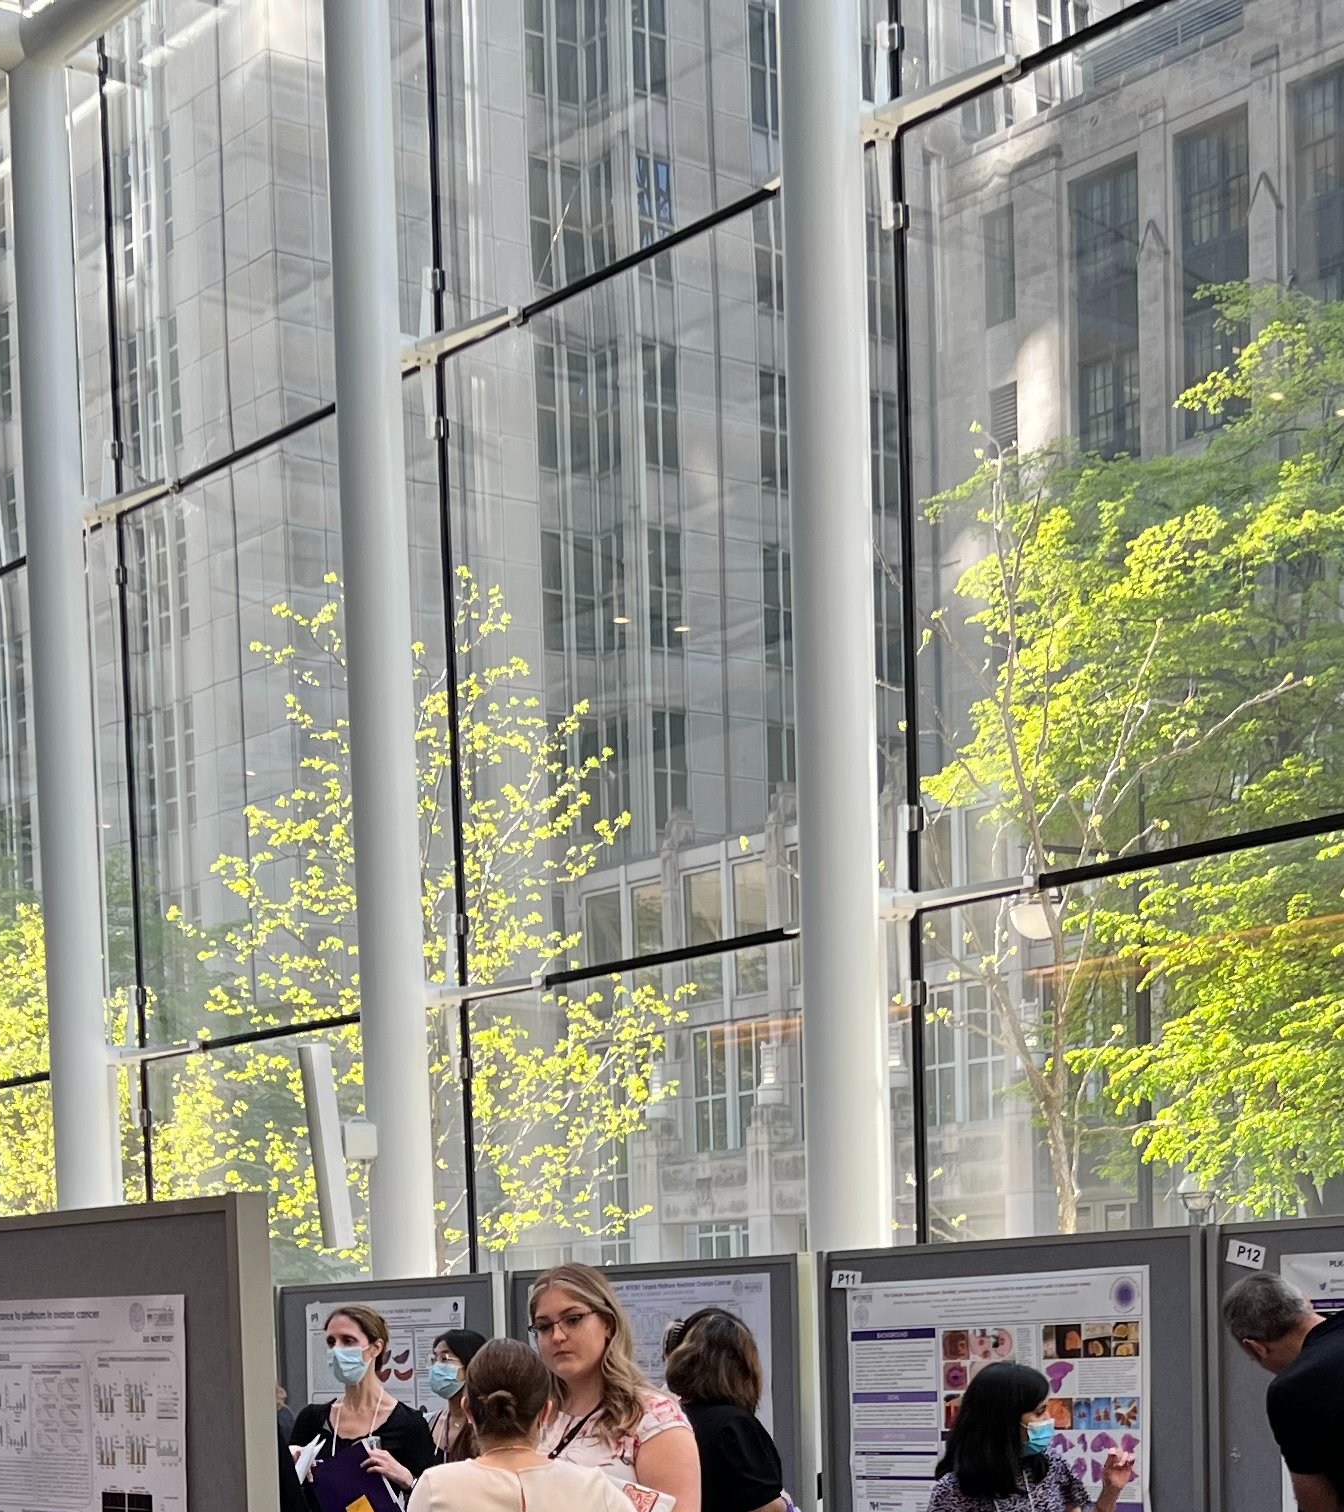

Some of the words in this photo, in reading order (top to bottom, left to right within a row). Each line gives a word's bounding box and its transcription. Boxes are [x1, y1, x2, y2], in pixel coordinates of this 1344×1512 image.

[1237, 1245, 1261, 1263] P12
[837, 1273, 856, 1285] P11
[76, 1310, 100, 1319] cancer
